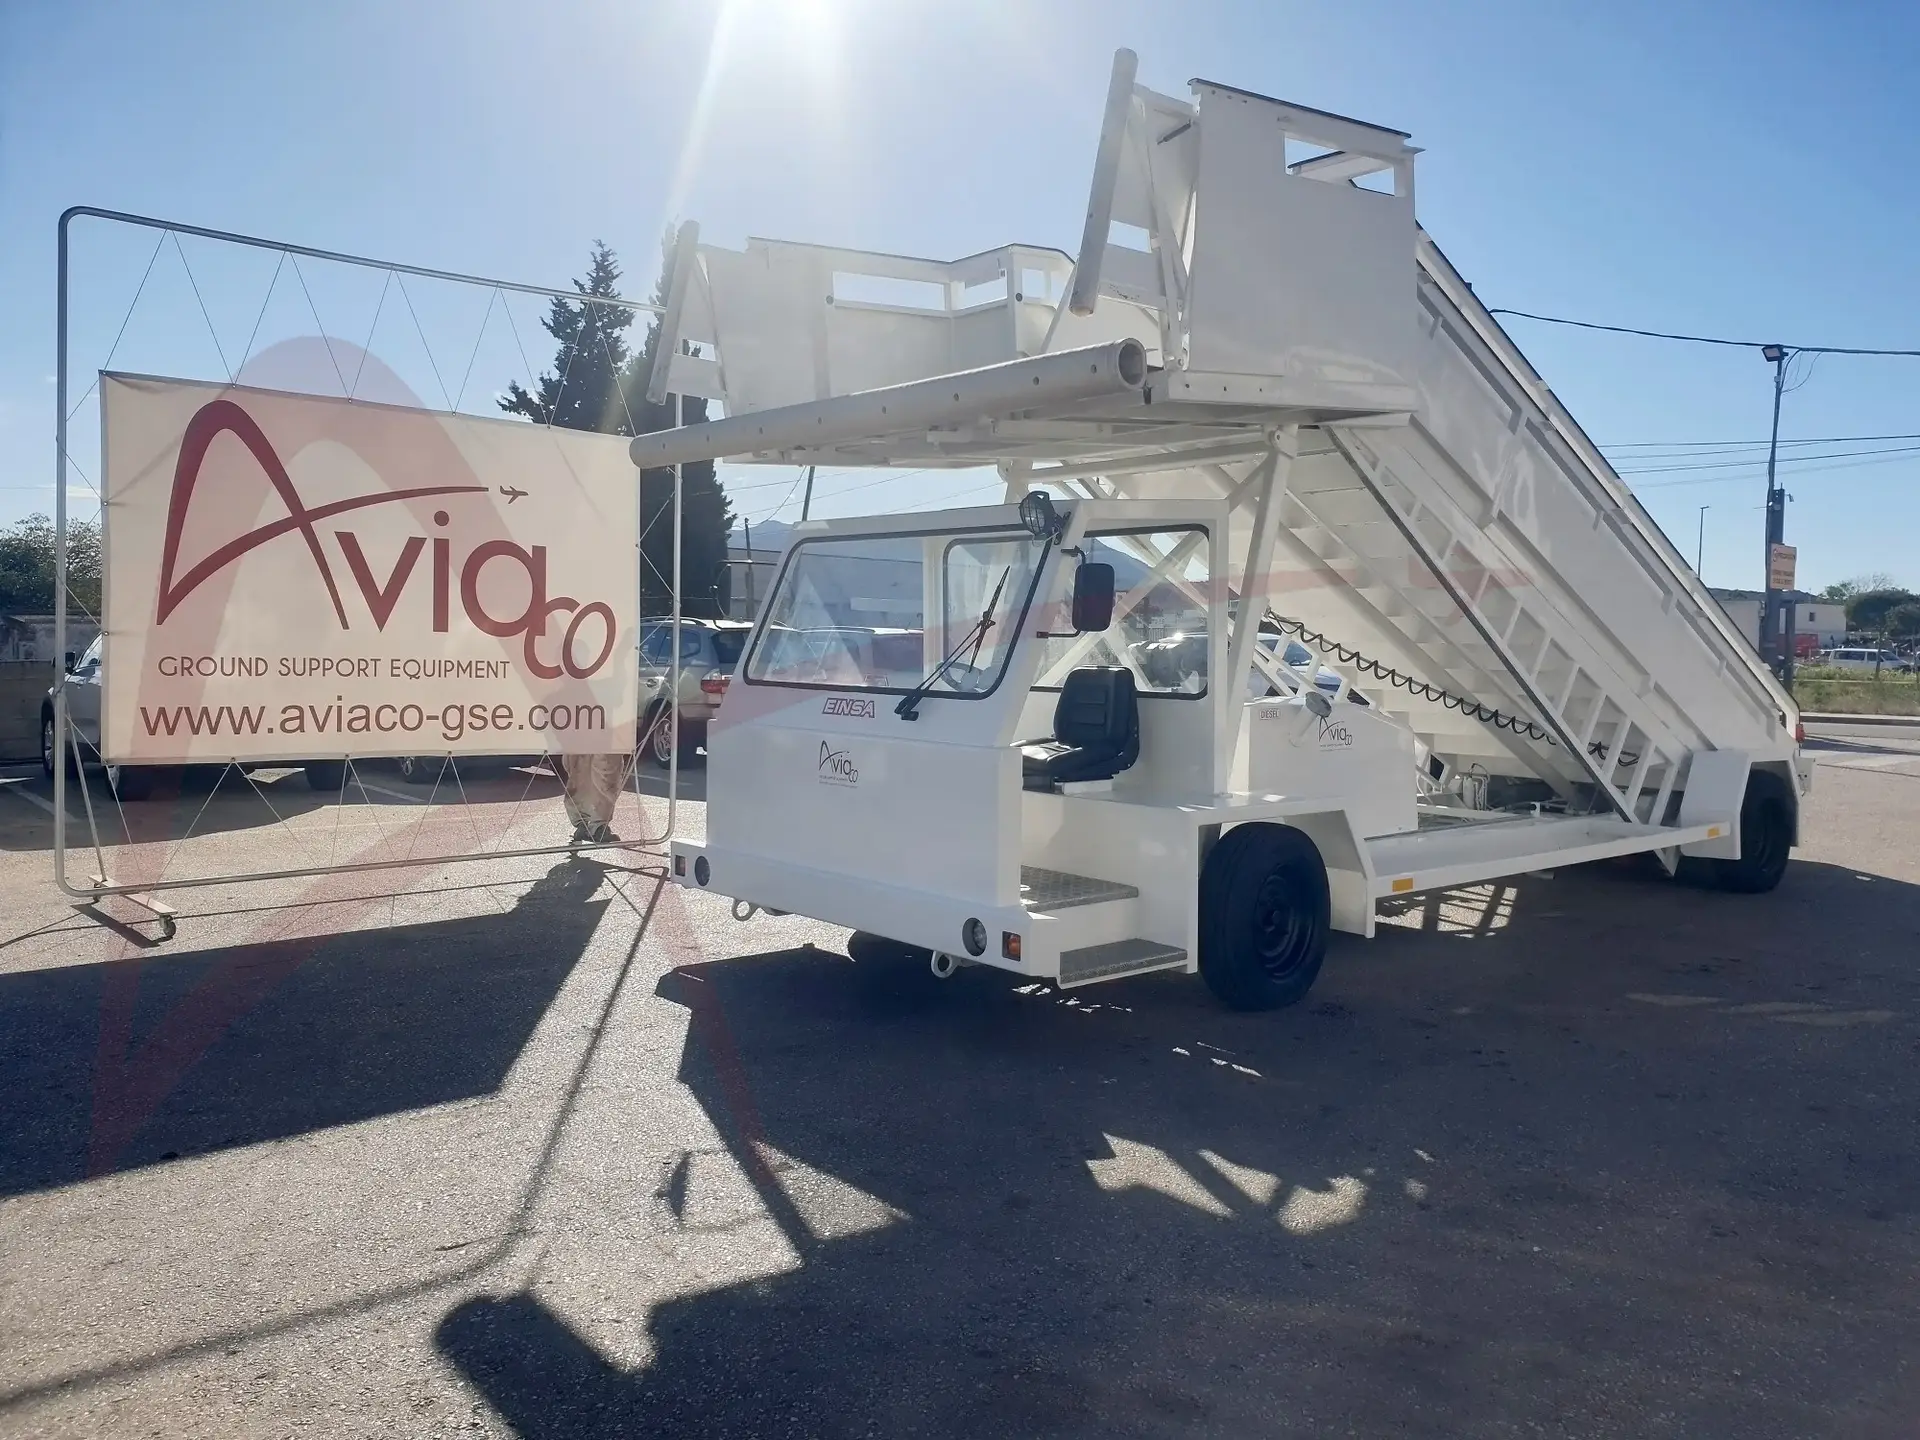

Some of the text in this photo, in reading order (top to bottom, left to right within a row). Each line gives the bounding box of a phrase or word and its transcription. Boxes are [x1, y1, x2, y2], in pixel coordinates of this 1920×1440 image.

[157, 656, 510, 680] GROUND SUPPORT EQUIPMENT
[140, 695, 605, 741] www.aviaco-gse.com
[822, 697, 875, 718] EINSA
